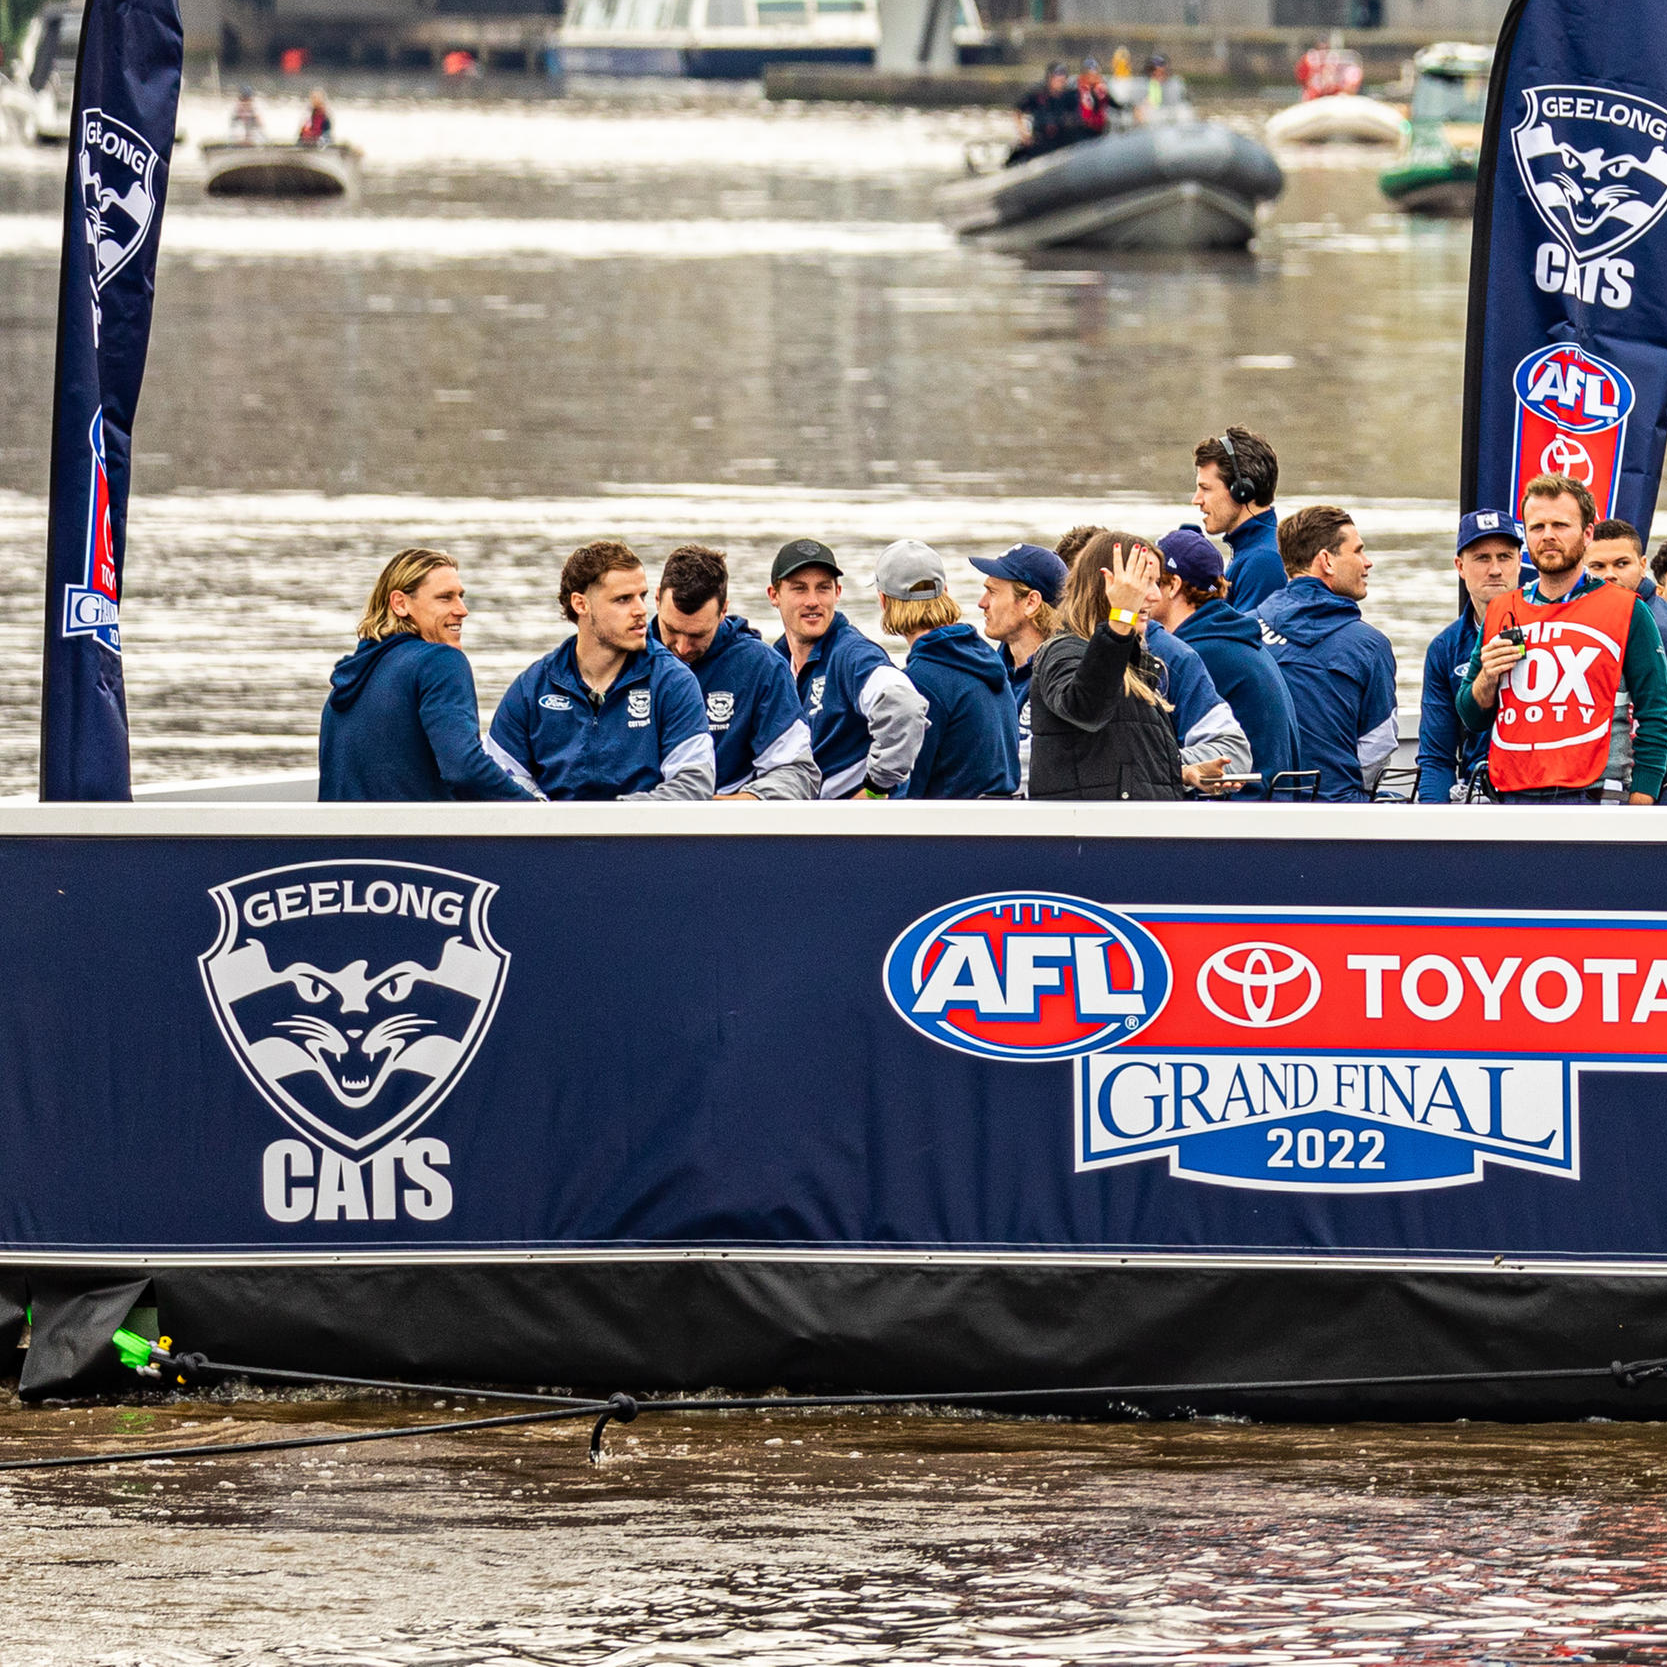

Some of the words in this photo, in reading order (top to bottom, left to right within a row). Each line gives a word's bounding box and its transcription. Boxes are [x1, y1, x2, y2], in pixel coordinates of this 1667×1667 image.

[1535, 242, 1635, 310] CATS
[1526, 360, 1620, 419] AFL
[1498, 705, 1595, 725] FOOTY
[244, 880, 466, 929] GEELONG
[910, 934, 1148, 1016] AFL
[1096, 1060, 1320, 1140] GRAND
[1331, 1063, 1558, 1151] FINAL
[262, 1137, 454, 1222] CATS
[1266, 1128, 1388, 1171] 2022
